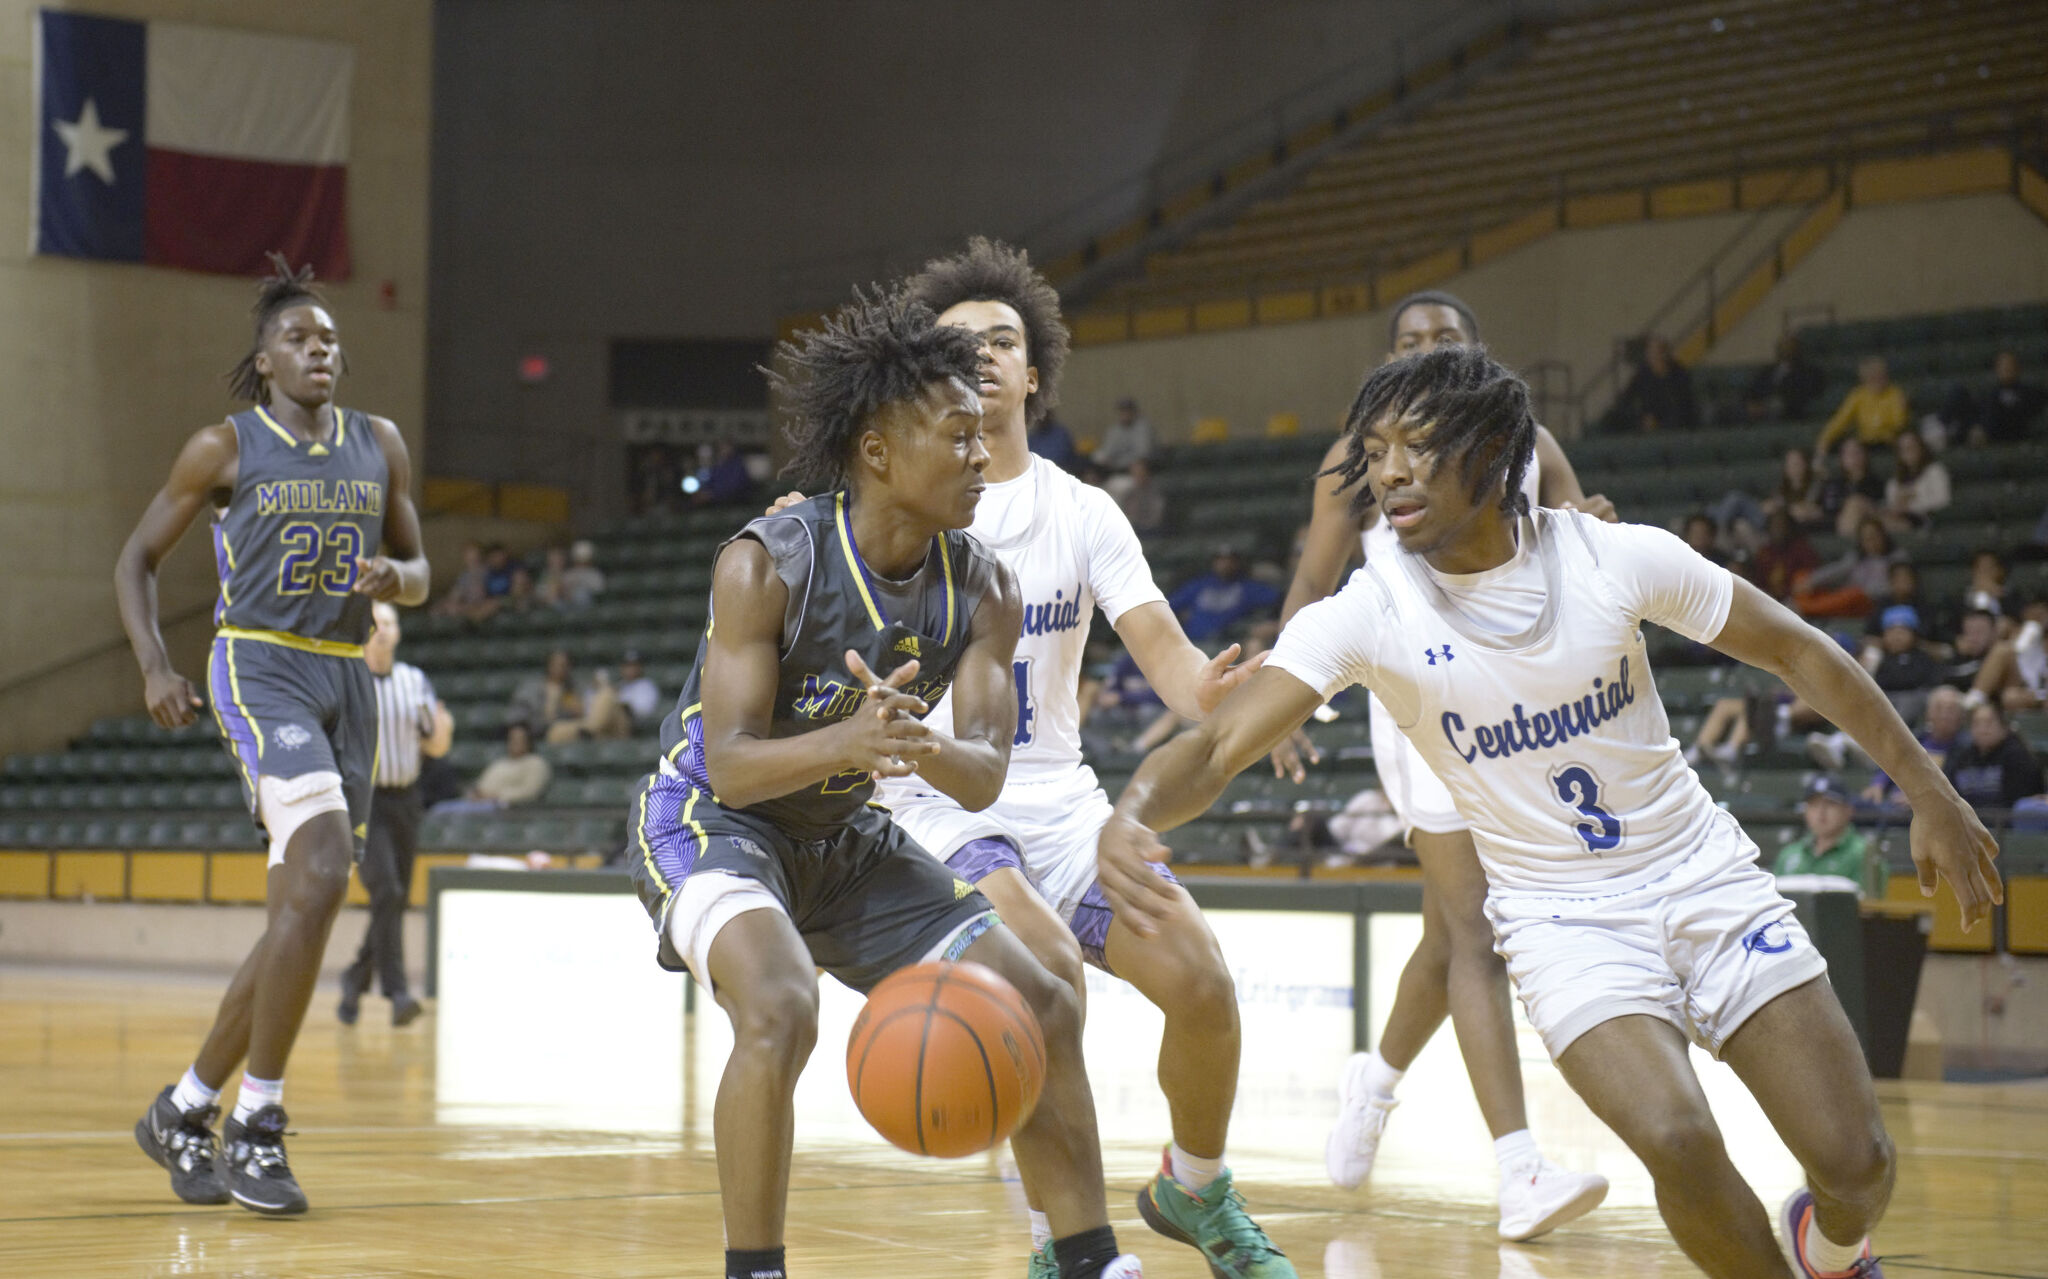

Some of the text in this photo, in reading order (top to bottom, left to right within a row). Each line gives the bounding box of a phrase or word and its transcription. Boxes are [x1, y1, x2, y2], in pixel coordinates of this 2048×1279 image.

[256, 479, 382, 516] MIDLAND
[277, 521, 364, 597] 23
[1020, 582, 1082, 638] nnial
[1441, 654, 1635, 765] Centennial
[1549, 763, 1624, 855] 3
